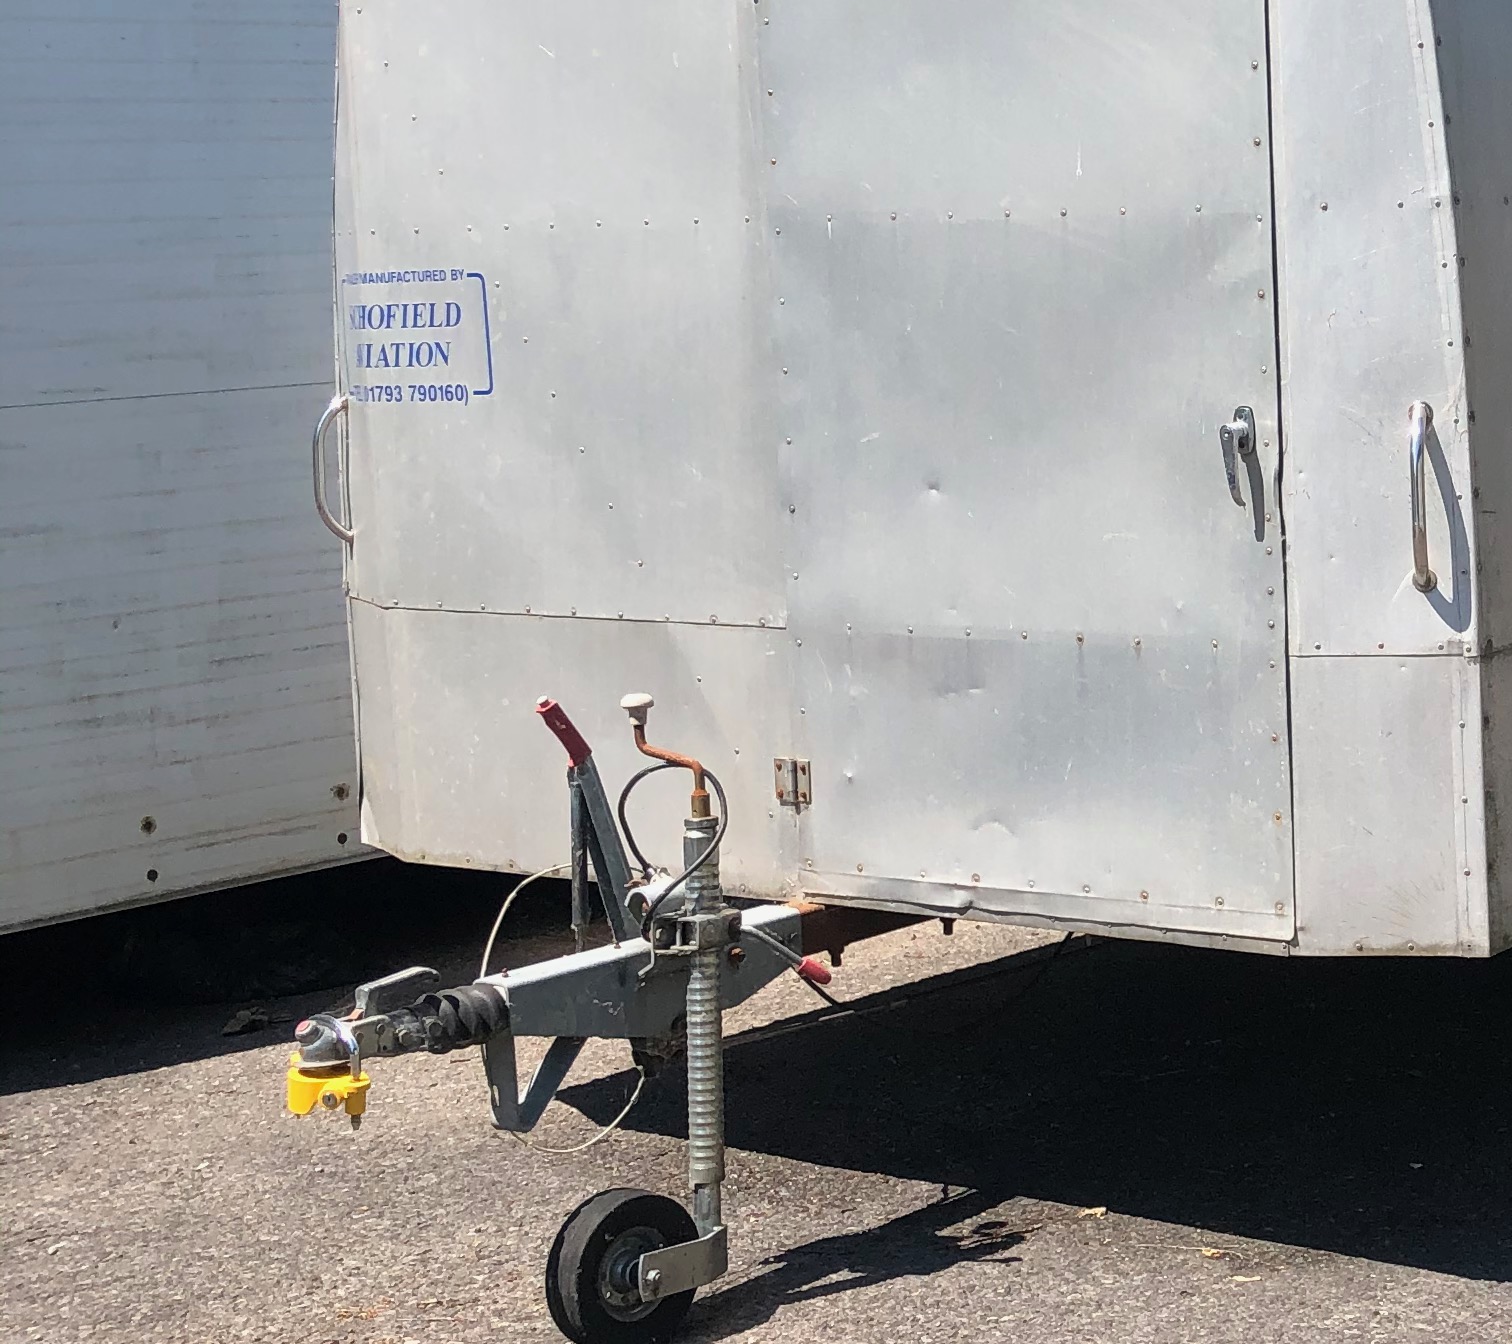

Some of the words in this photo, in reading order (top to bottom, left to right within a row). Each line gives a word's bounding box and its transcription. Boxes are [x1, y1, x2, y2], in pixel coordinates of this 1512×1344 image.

[450, 268, 465, 281] BY
[355, 341, 452, 369] IATION
[407, 384, 469, 406] 790160)
